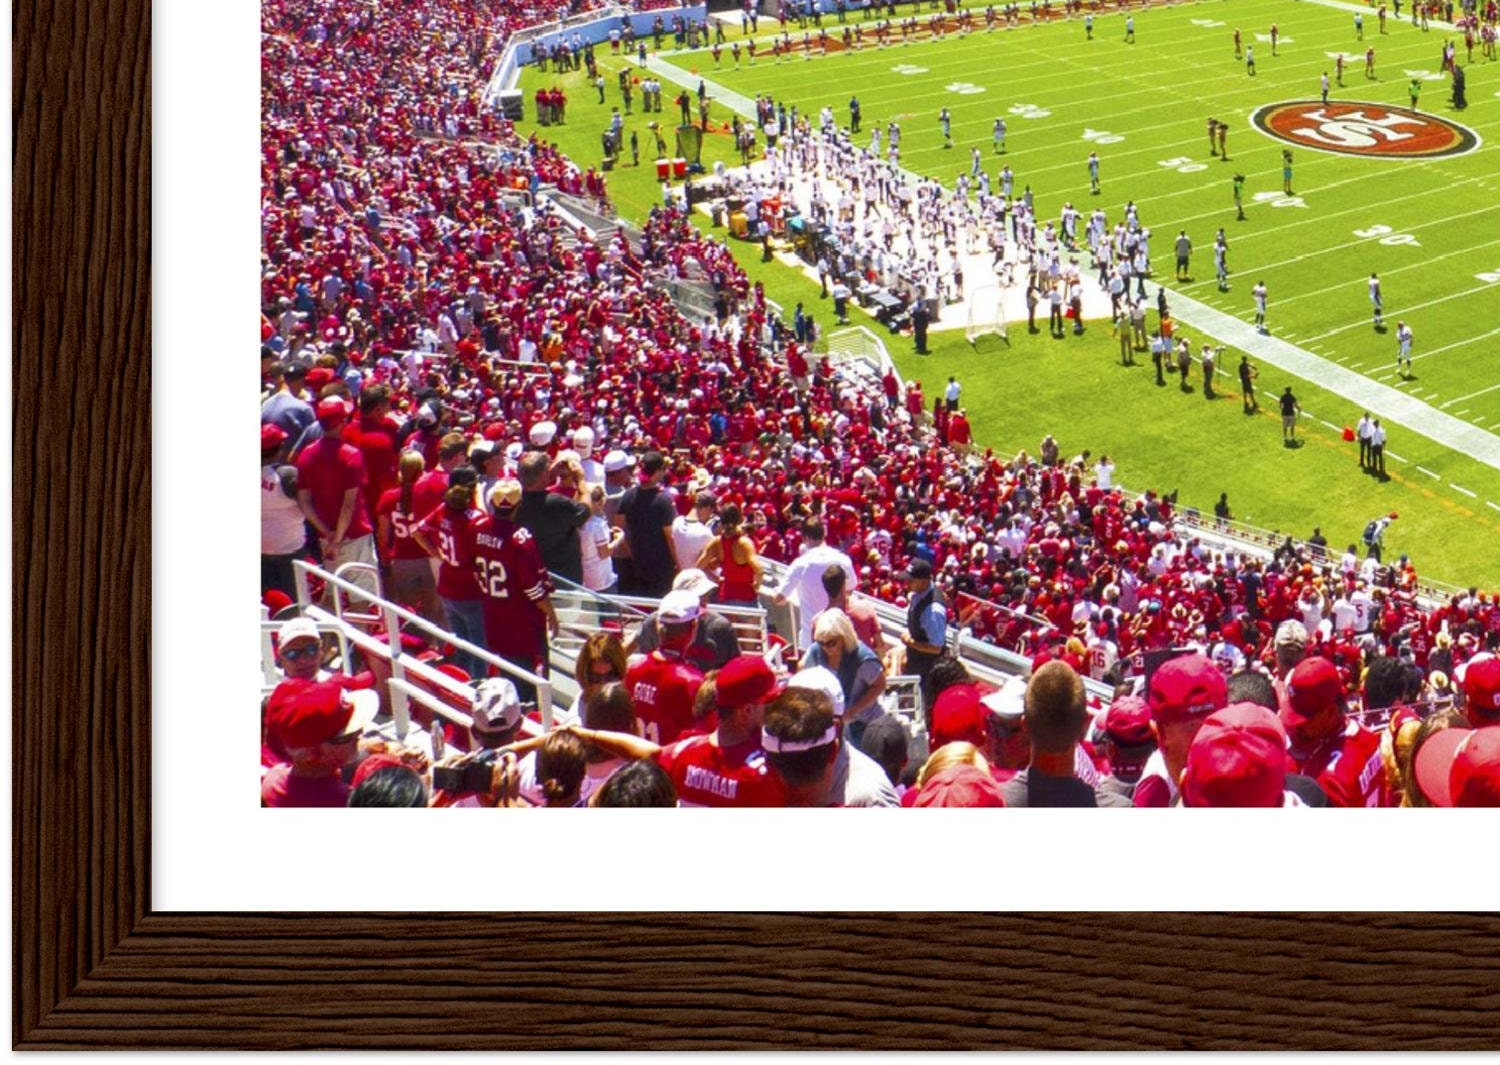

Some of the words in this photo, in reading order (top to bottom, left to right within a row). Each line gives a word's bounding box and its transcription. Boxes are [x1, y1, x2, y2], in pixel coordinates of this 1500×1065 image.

[1157, 156, 1209, 174] 50
[1352, 224, 1421, 247] 30
[473, 556, 509, 598] 32
